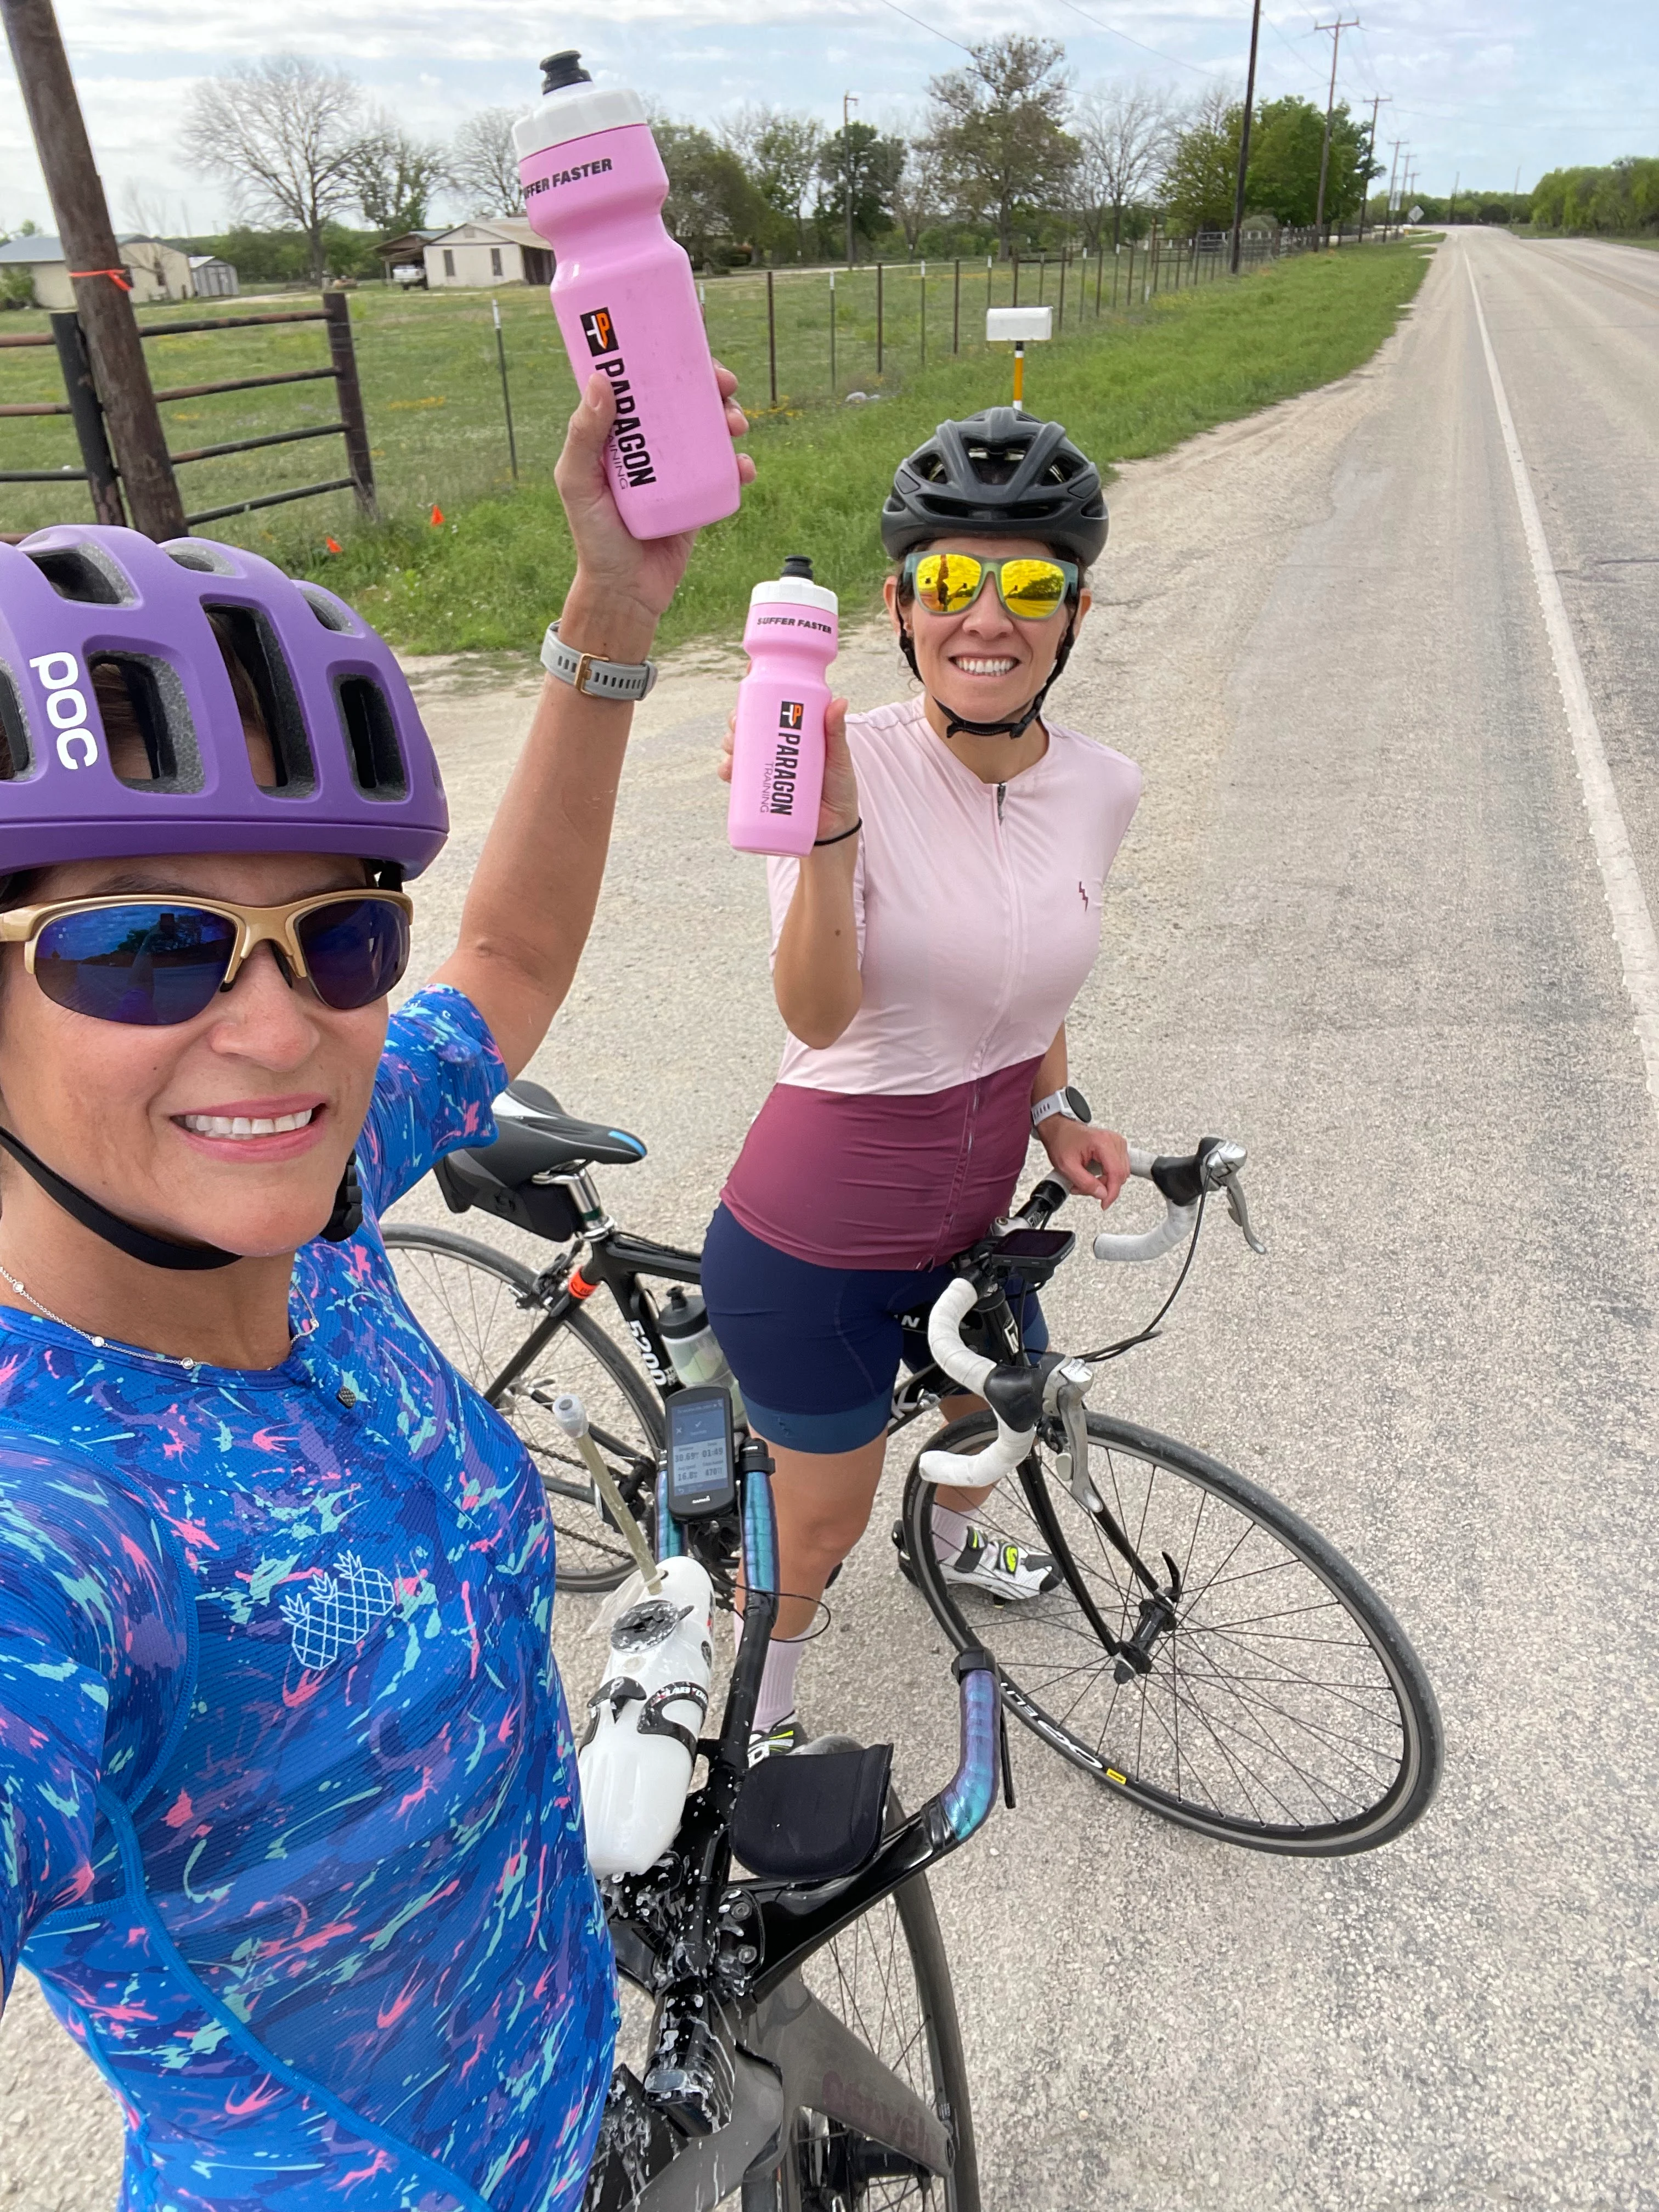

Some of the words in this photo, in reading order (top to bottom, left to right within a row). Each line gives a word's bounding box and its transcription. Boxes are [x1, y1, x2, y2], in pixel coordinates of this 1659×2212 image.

[552, 158, 613, 188] FASTER
[608, 433, 628, 490] AINING
[757, 617, 795, 626] SUFFER
[798, 619, 832, 634] FASTER
[760, 761, 774, 813] TRAINING
[770, 732, 801, 816] PARAGON
[629, 1320, 667, 1386] 5200
